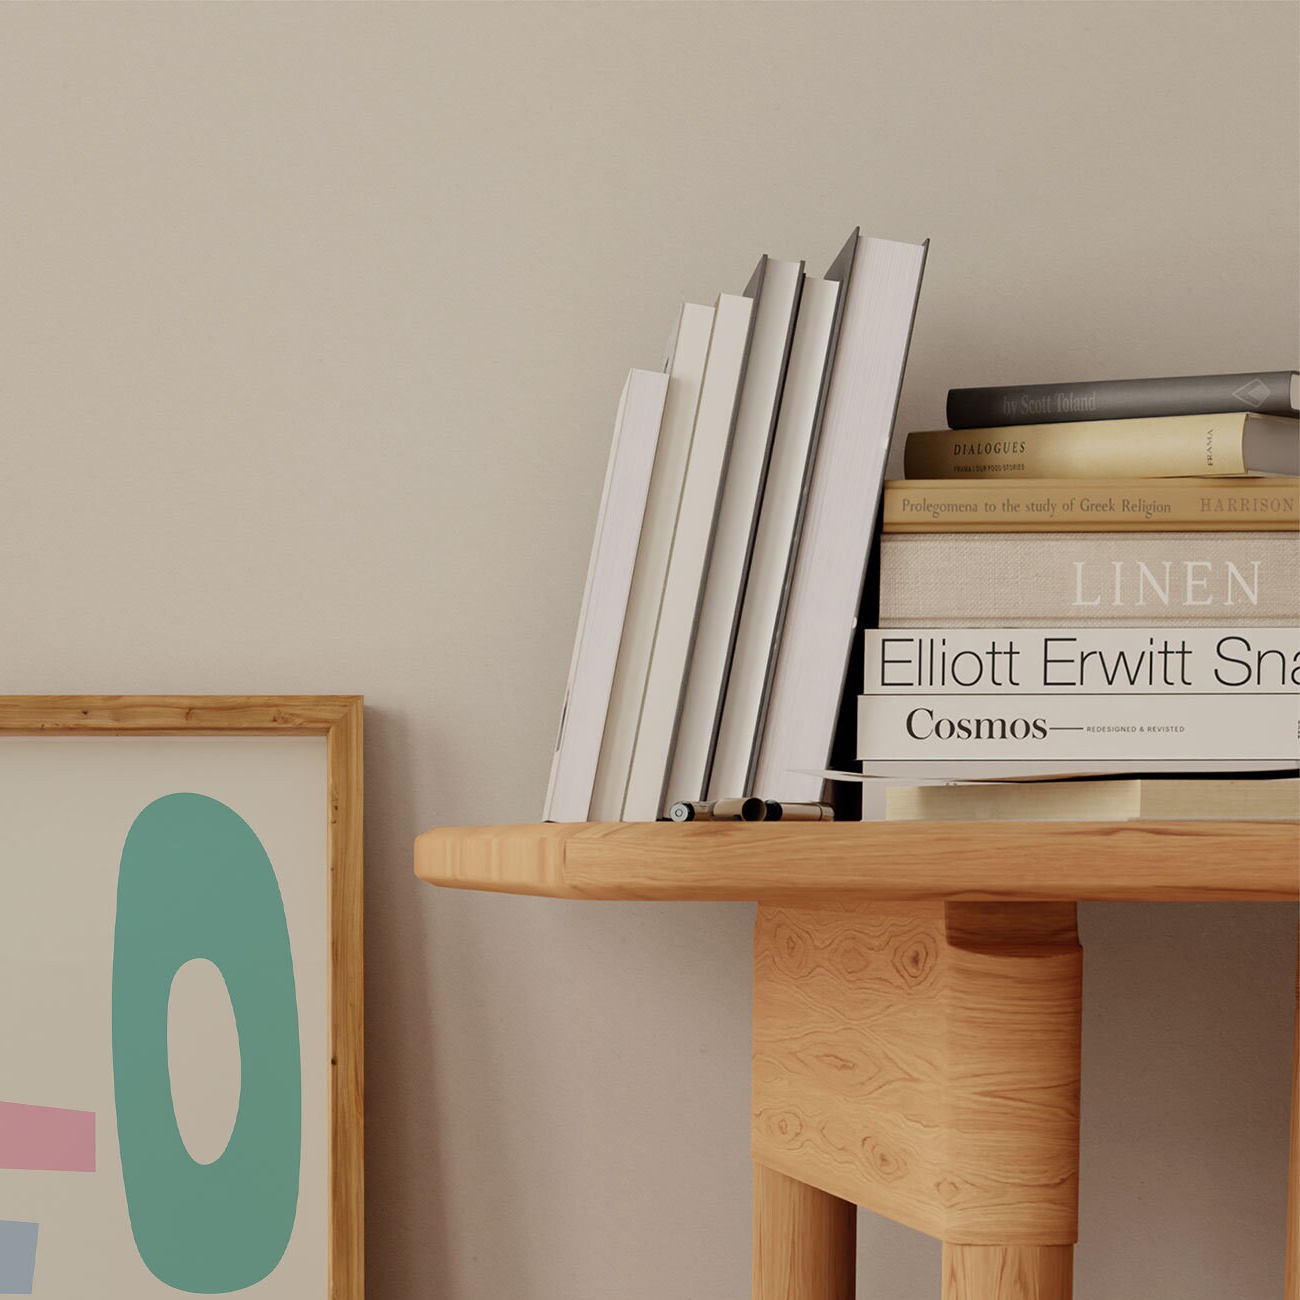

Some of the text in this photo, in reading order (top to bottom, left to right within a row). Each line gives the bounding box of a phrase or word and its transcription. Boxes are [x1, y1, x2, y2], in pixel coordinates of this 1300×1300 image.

[1020, 394, 1052, 415] Scott
[1055, 392, 1097, 412] Toland
[953, 441, 1026, 456] DIALOGUES
[1206, 428, 1214, 466] FRAMA
[902, 499, 1172, 518] Prolegomena to the study of Greek Religion
[1200, 497, 1294, 513] HARRISON
[1072, 561, 1261, 606] LINEN
[881, 638, 1020, 686] Elliott
[1043, 637, 1192, 686] Erwitt
[906, 707, 1048, 740] Cosmos
